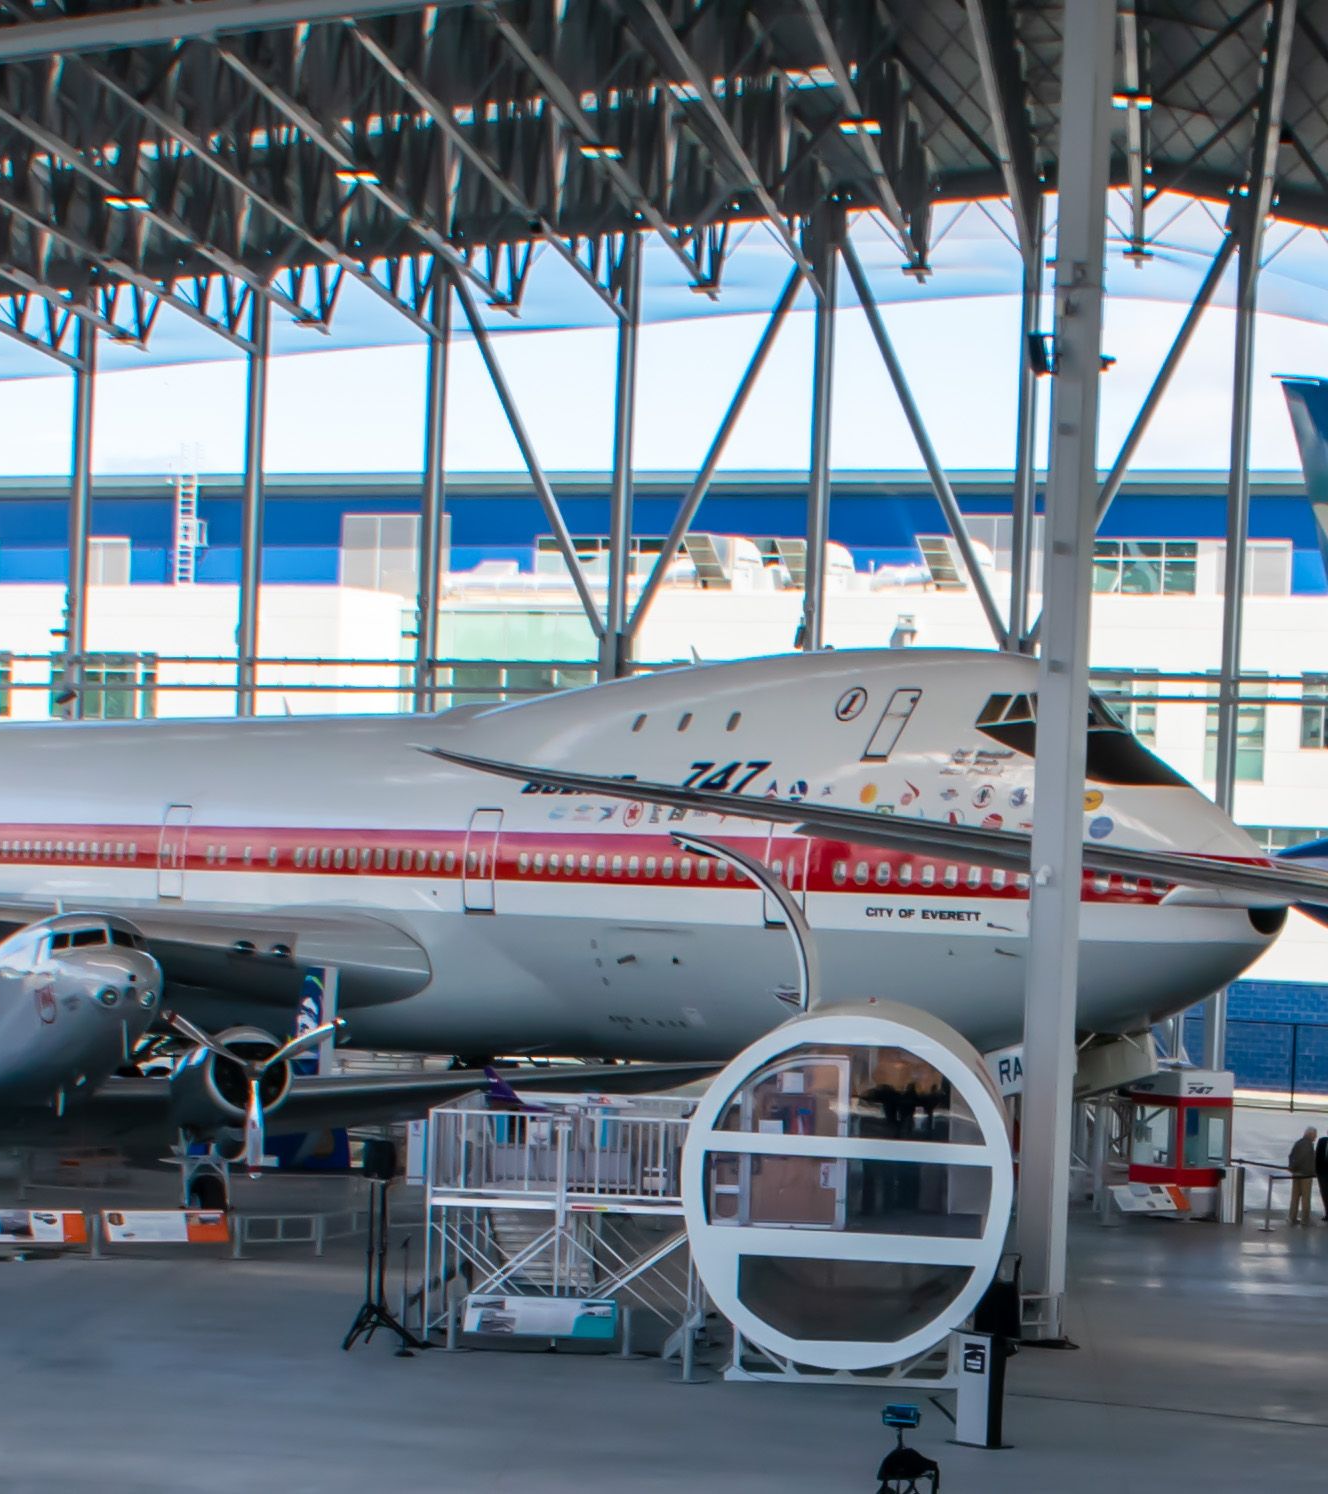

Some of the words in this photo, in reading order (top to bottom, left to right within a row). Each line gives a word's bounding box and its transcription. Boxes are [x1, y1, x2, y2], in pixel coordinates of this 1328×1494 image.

[681, 760, 771, 793] 747
[865, 906, 893, 918] CITY
[898, 908, 916, 919] OF
[921, 909, 982, 922] EVERETT
